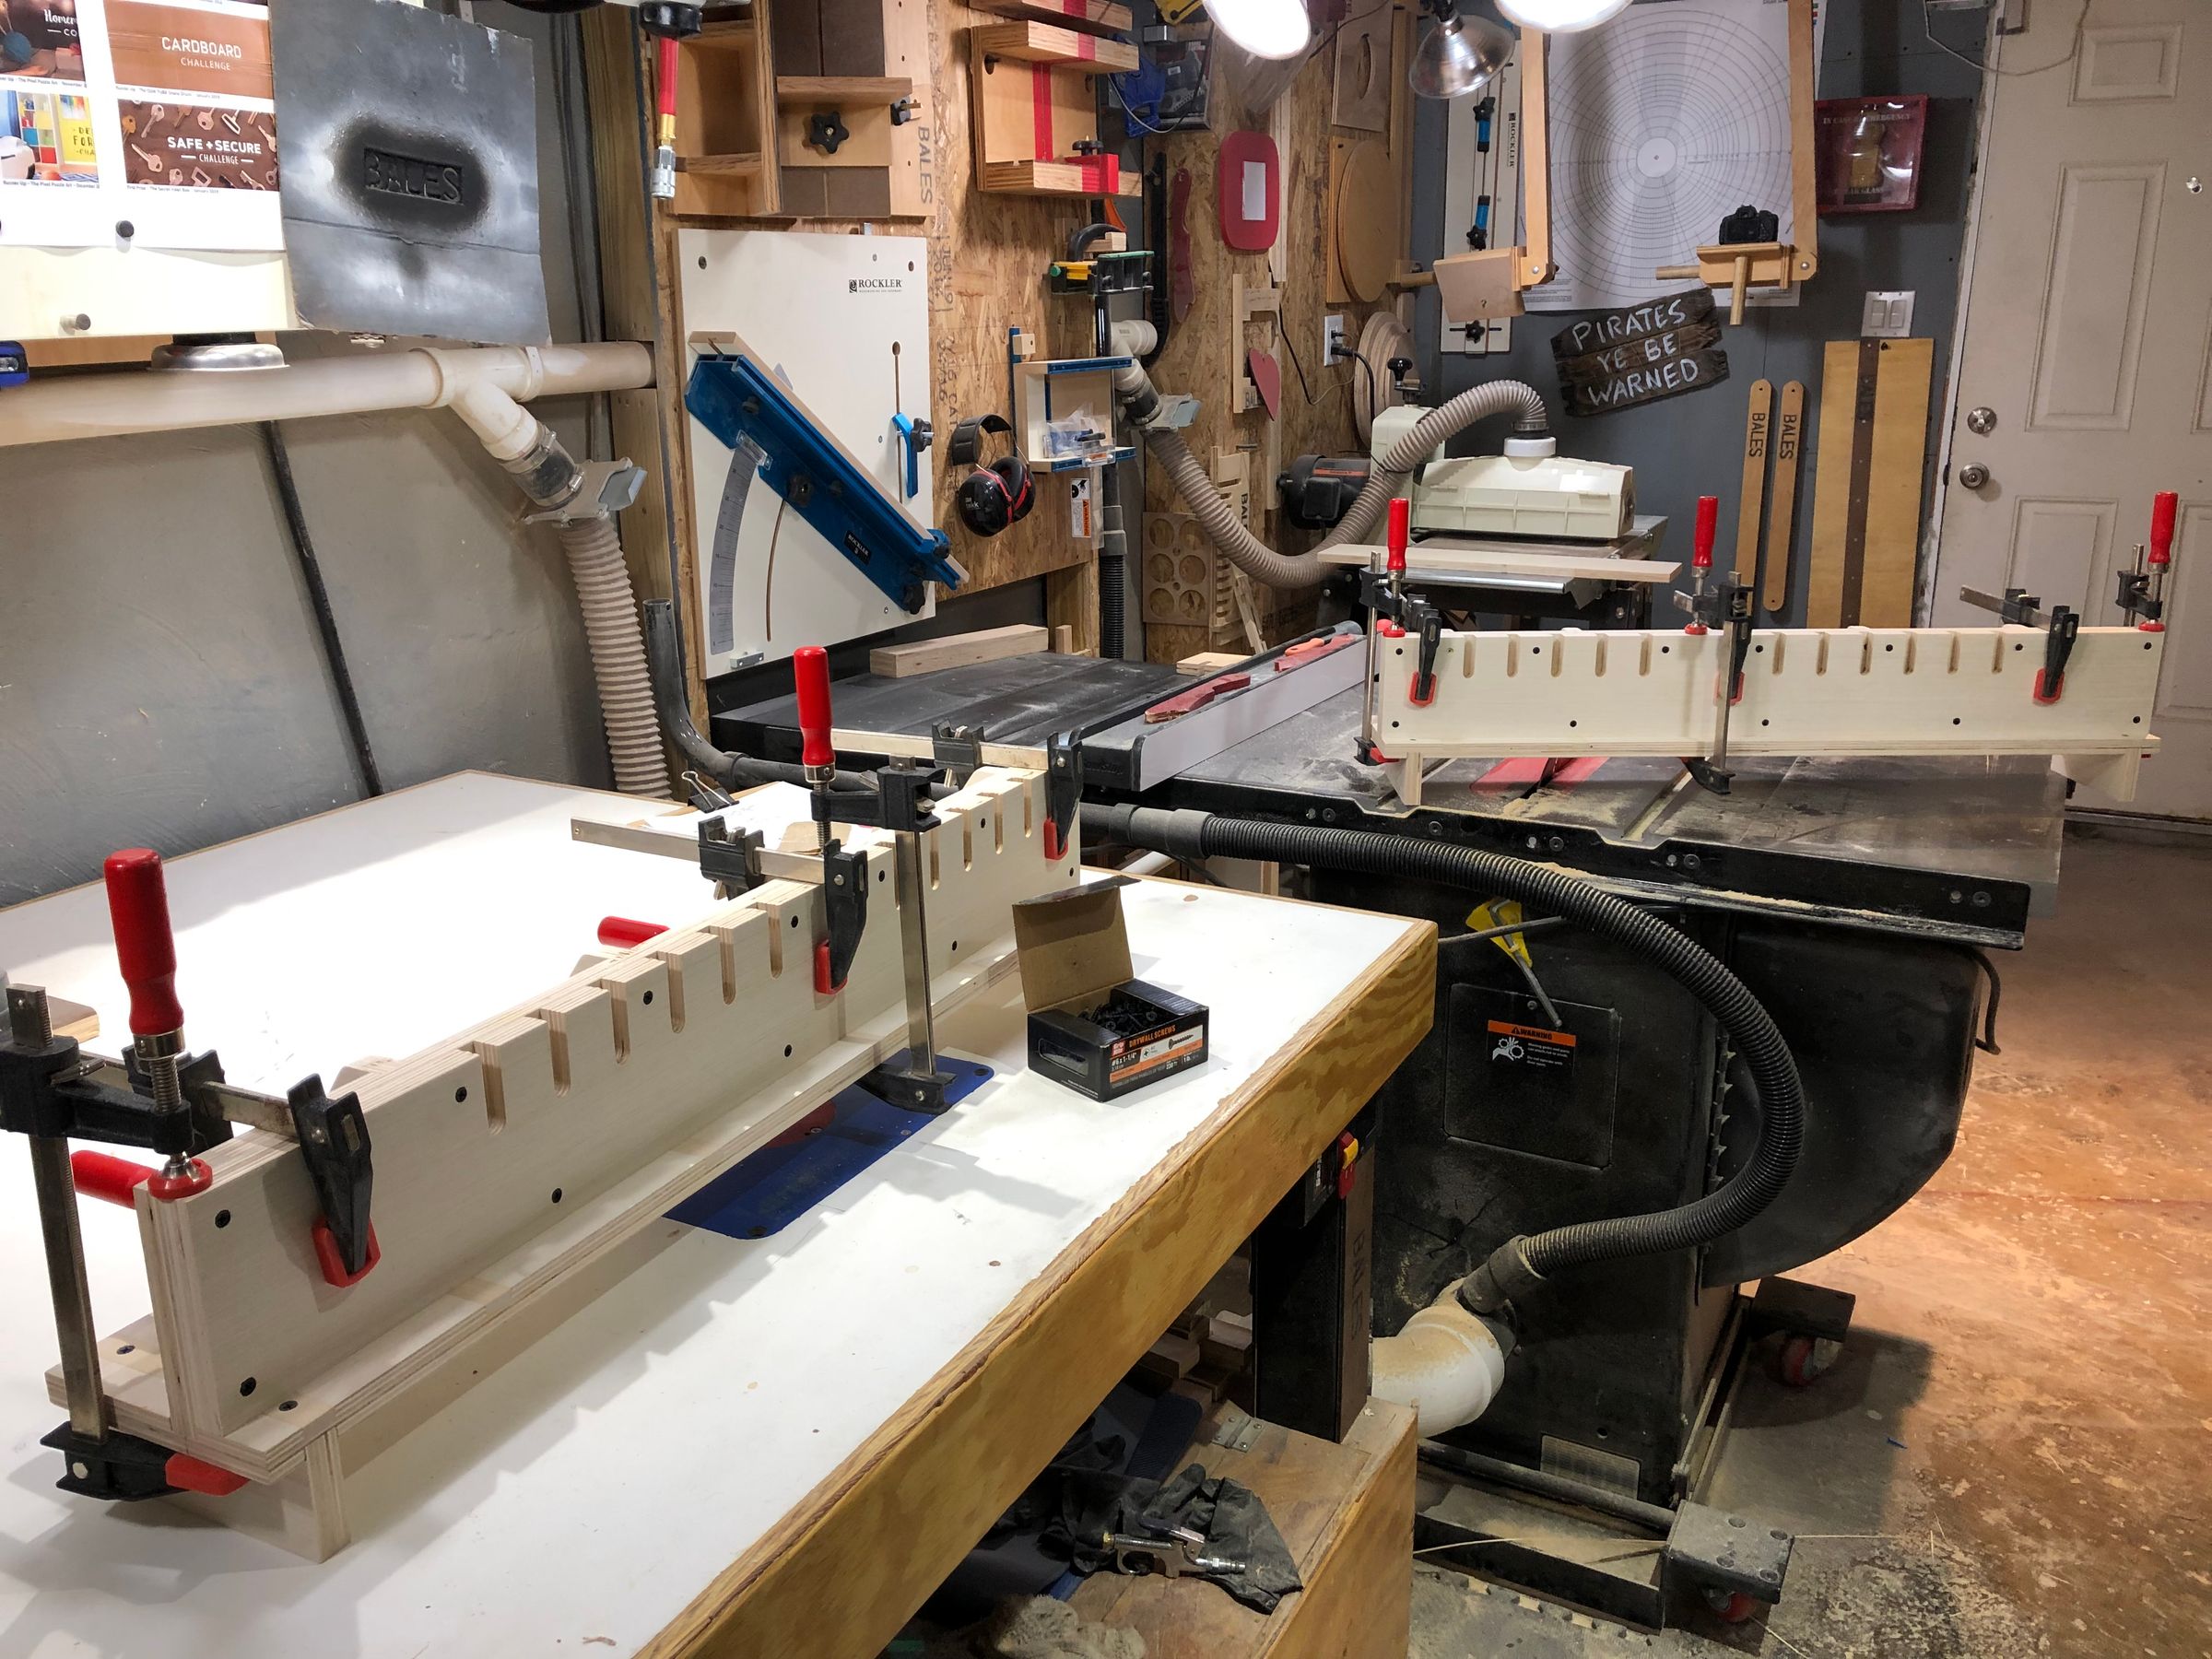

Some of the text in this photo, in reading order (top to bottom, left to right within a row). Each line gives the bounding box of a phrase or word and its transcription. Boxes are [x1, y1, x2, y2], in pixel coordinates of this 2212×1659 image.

[161, 36, 241, 59] CARDBOARD
[181, 57, 230, 71] CHALLENGE
[167, 135, 204, 151] SAFE
[214, 139, 262, 155] SECURE
[199, 155, 239, 165] CHALLENGE
[917, 125, 935, 206] BALES
[858, 278, 902, 288] ROCKLER
[1572, 299, 1686, 351] PIRATES
[1597, 333, 1677, 373] YE BE
[1588, 358, 1699, 406] WARNED
[1749, 412, 1766, 458] BALES
[1780, 414, 1797, 460] BALES
[1129, 1024, 1176, 1048] DRYWALL SCREWS
[1520, 1028, 1553, 1041] WARNING
